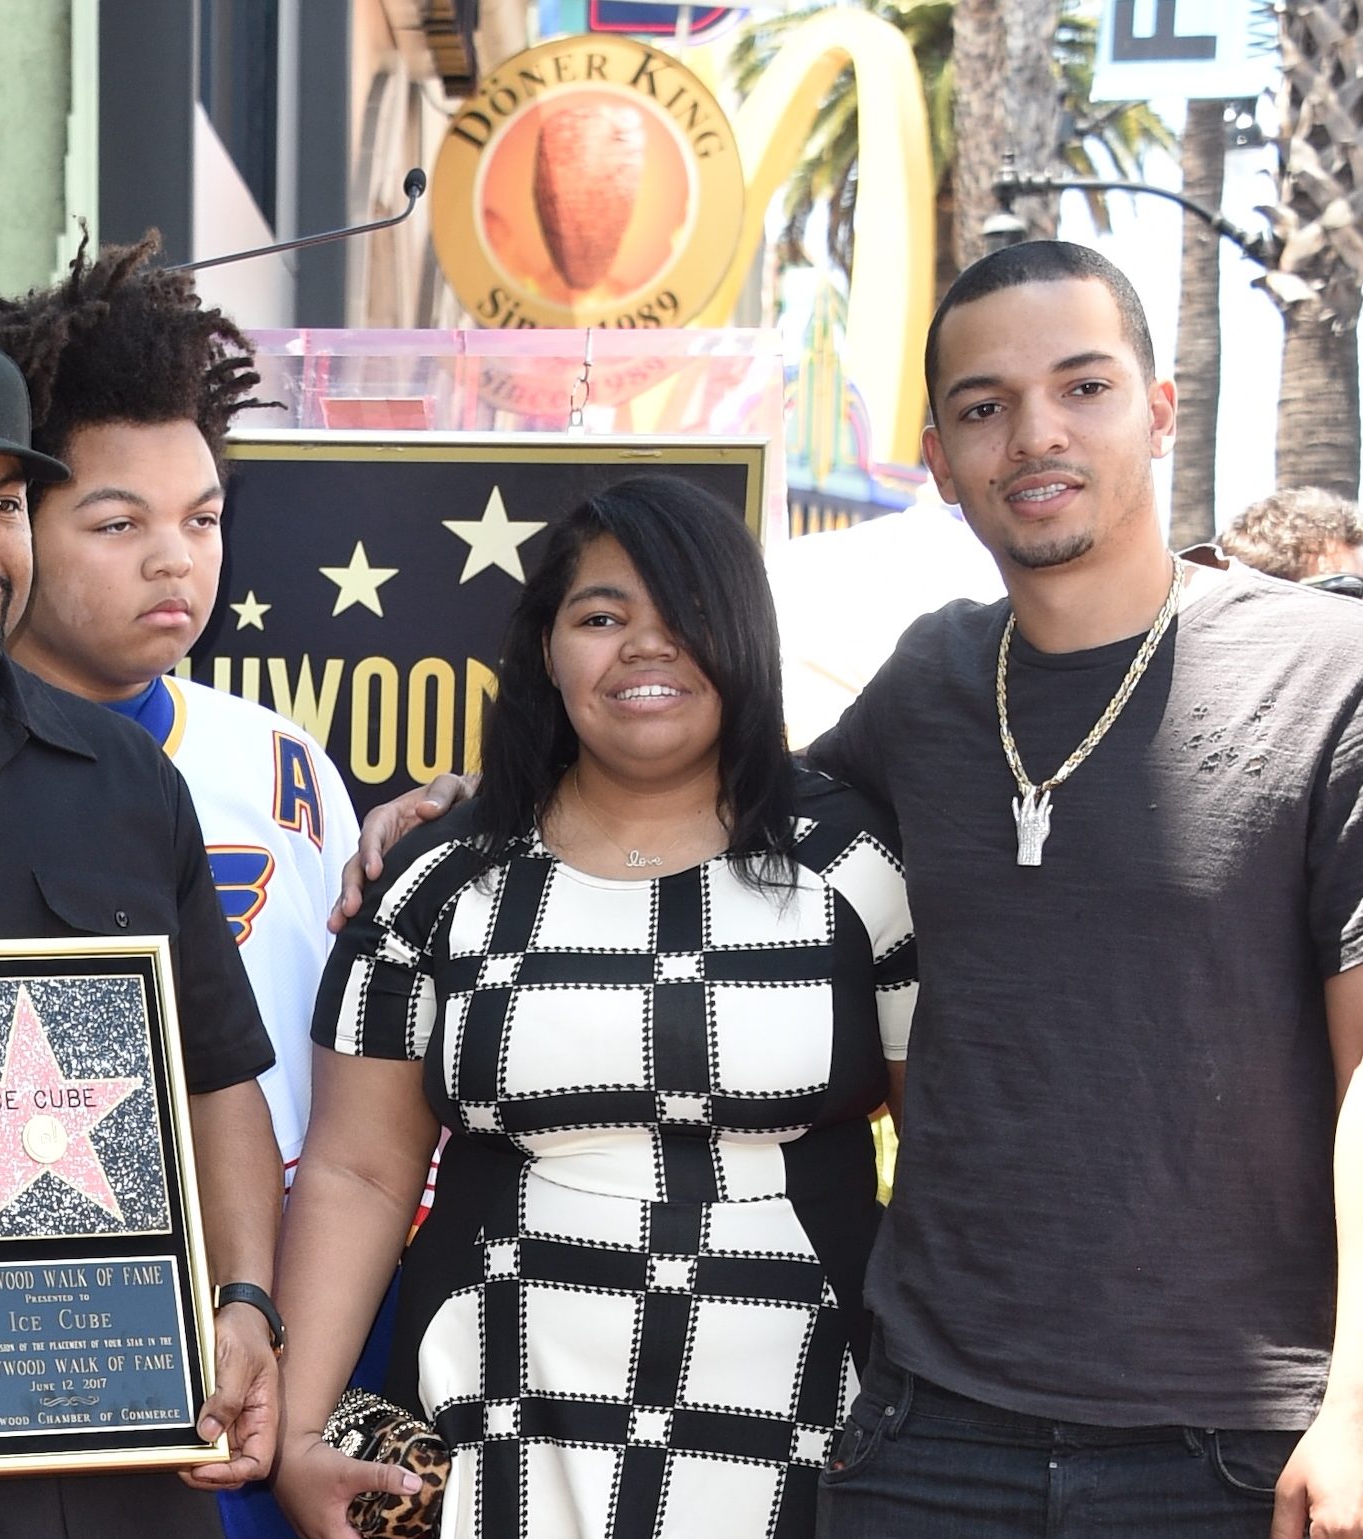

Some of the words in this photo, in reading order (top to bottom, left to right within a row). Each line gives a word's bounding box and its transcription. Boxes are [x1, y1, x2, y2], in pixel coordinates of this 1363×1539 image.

[451, 52, 609, 151] DÖNER
[624, 52, 726, 160] KING
[271, 729, 325, 855] A
[625, 849, 664, 867] love
[33, 1088, 98, 1110] CUBE
[43, 1268, 88, 1289] WALK
[96, 1267, 114, 1287] OF
[123, 1265, 164, 1286] FAME
[25, 1293, 74, 1304] PRESENTED
[79, 1293, 90, 1302] TO
[8, 1311, 42, 1333] ICE
[58, 1308, 113, 1330] CUBE
[19, 1342, 28, 1352] OF
[32, 1341, 45, 1351] THE
[49, 1339, 87, 1351] PLACEMENT
[90, 1339, 100, 1349] OF
[103, 1339, 123, 1348] YOUR
[126, 1337, 144, 1347] STAR
[148, 1337, 156, 1347] IN
[159, 1336, 173, 1346] THE
[55, 1356, 99, 1374] WALK
[107, 1355, 125, 1372] OF
[134, 1353, 175, 1371] FAME
[29, 1380, 56, 1392] JUNE
[62, 1379, 75, 1391] 12
[82, 1377, 107, 1390] 2017
[37, 1411, 91, 1425] CHAMBER
[100, 1412, 113, 1423] OF
[120, 1408, 181, 1421] COMMERCE
